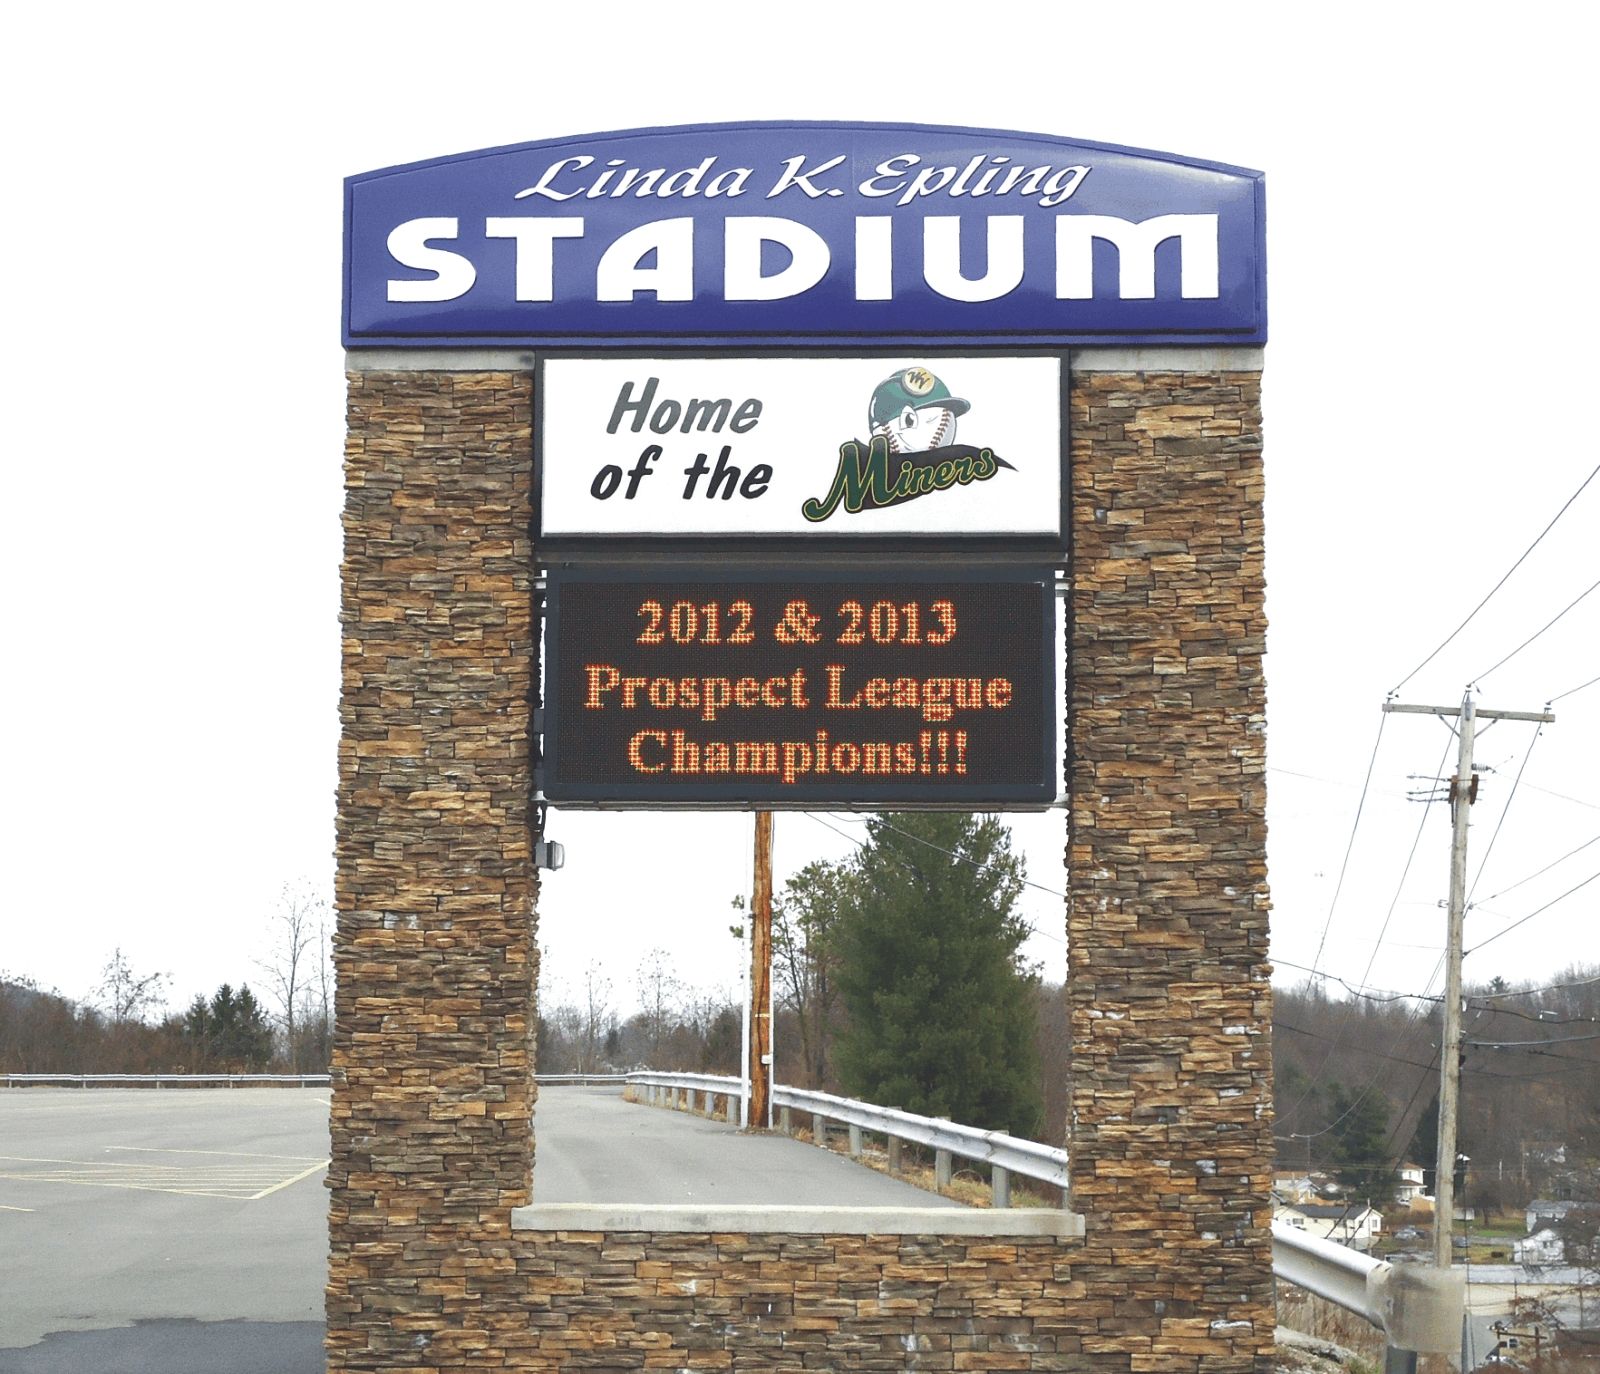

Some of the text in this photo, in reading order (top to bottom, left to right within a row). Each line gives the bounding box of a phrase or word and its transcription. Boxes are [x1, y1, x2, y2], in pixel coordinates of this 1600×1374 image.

[514, 153, 1093, 208] Linda K. Epling
[386, 213, 1220, 303] STADIUM
[606, 377, 763, 435] Home
[590, 444, 774, 500] of the
[801, 434, 999, 522] Miners
[636, 600, 957, 645] 2012 & 2013
[584, 664, 1013, 722] Prospect League
[627, 729, 968, 784] Champions!!!
